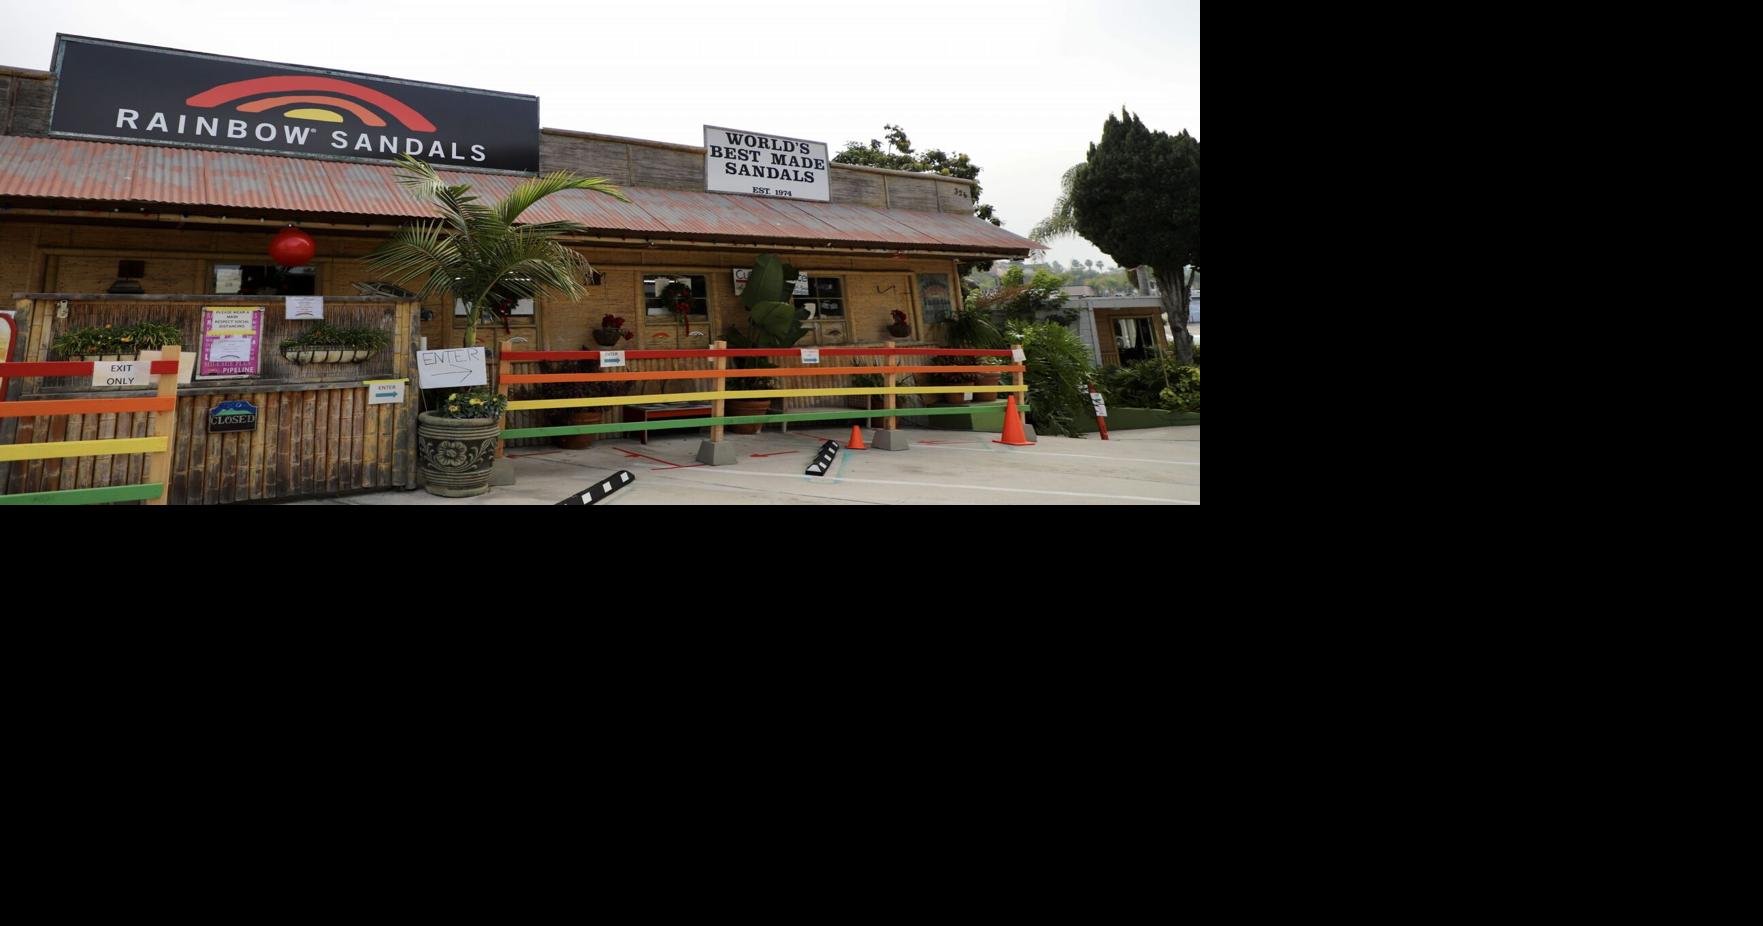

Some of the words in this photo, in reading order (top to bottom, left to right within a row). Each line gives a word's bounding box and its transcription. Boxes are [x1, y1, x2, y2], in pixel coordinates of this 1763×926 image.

[116, 108, 310, 145] RAINBOW
[331, 130, 486, 162] SANDALS
[725, 132, 811, 155] WORLD'S
[710, 145, 761, 162] BEST
[771, 153, 825, 171] MADE
[725, 162, 815, 183] SANDALS
[775, 189, 793, 197] 1974
[422, 348, 480, 366] ENTER
[110, 364, 133, 372] EXIT
[222, 366, 255, 374] PIPELINE
[106, 377, 135, 385] ONLY
[210, 414, 255, 425] CLOSED
